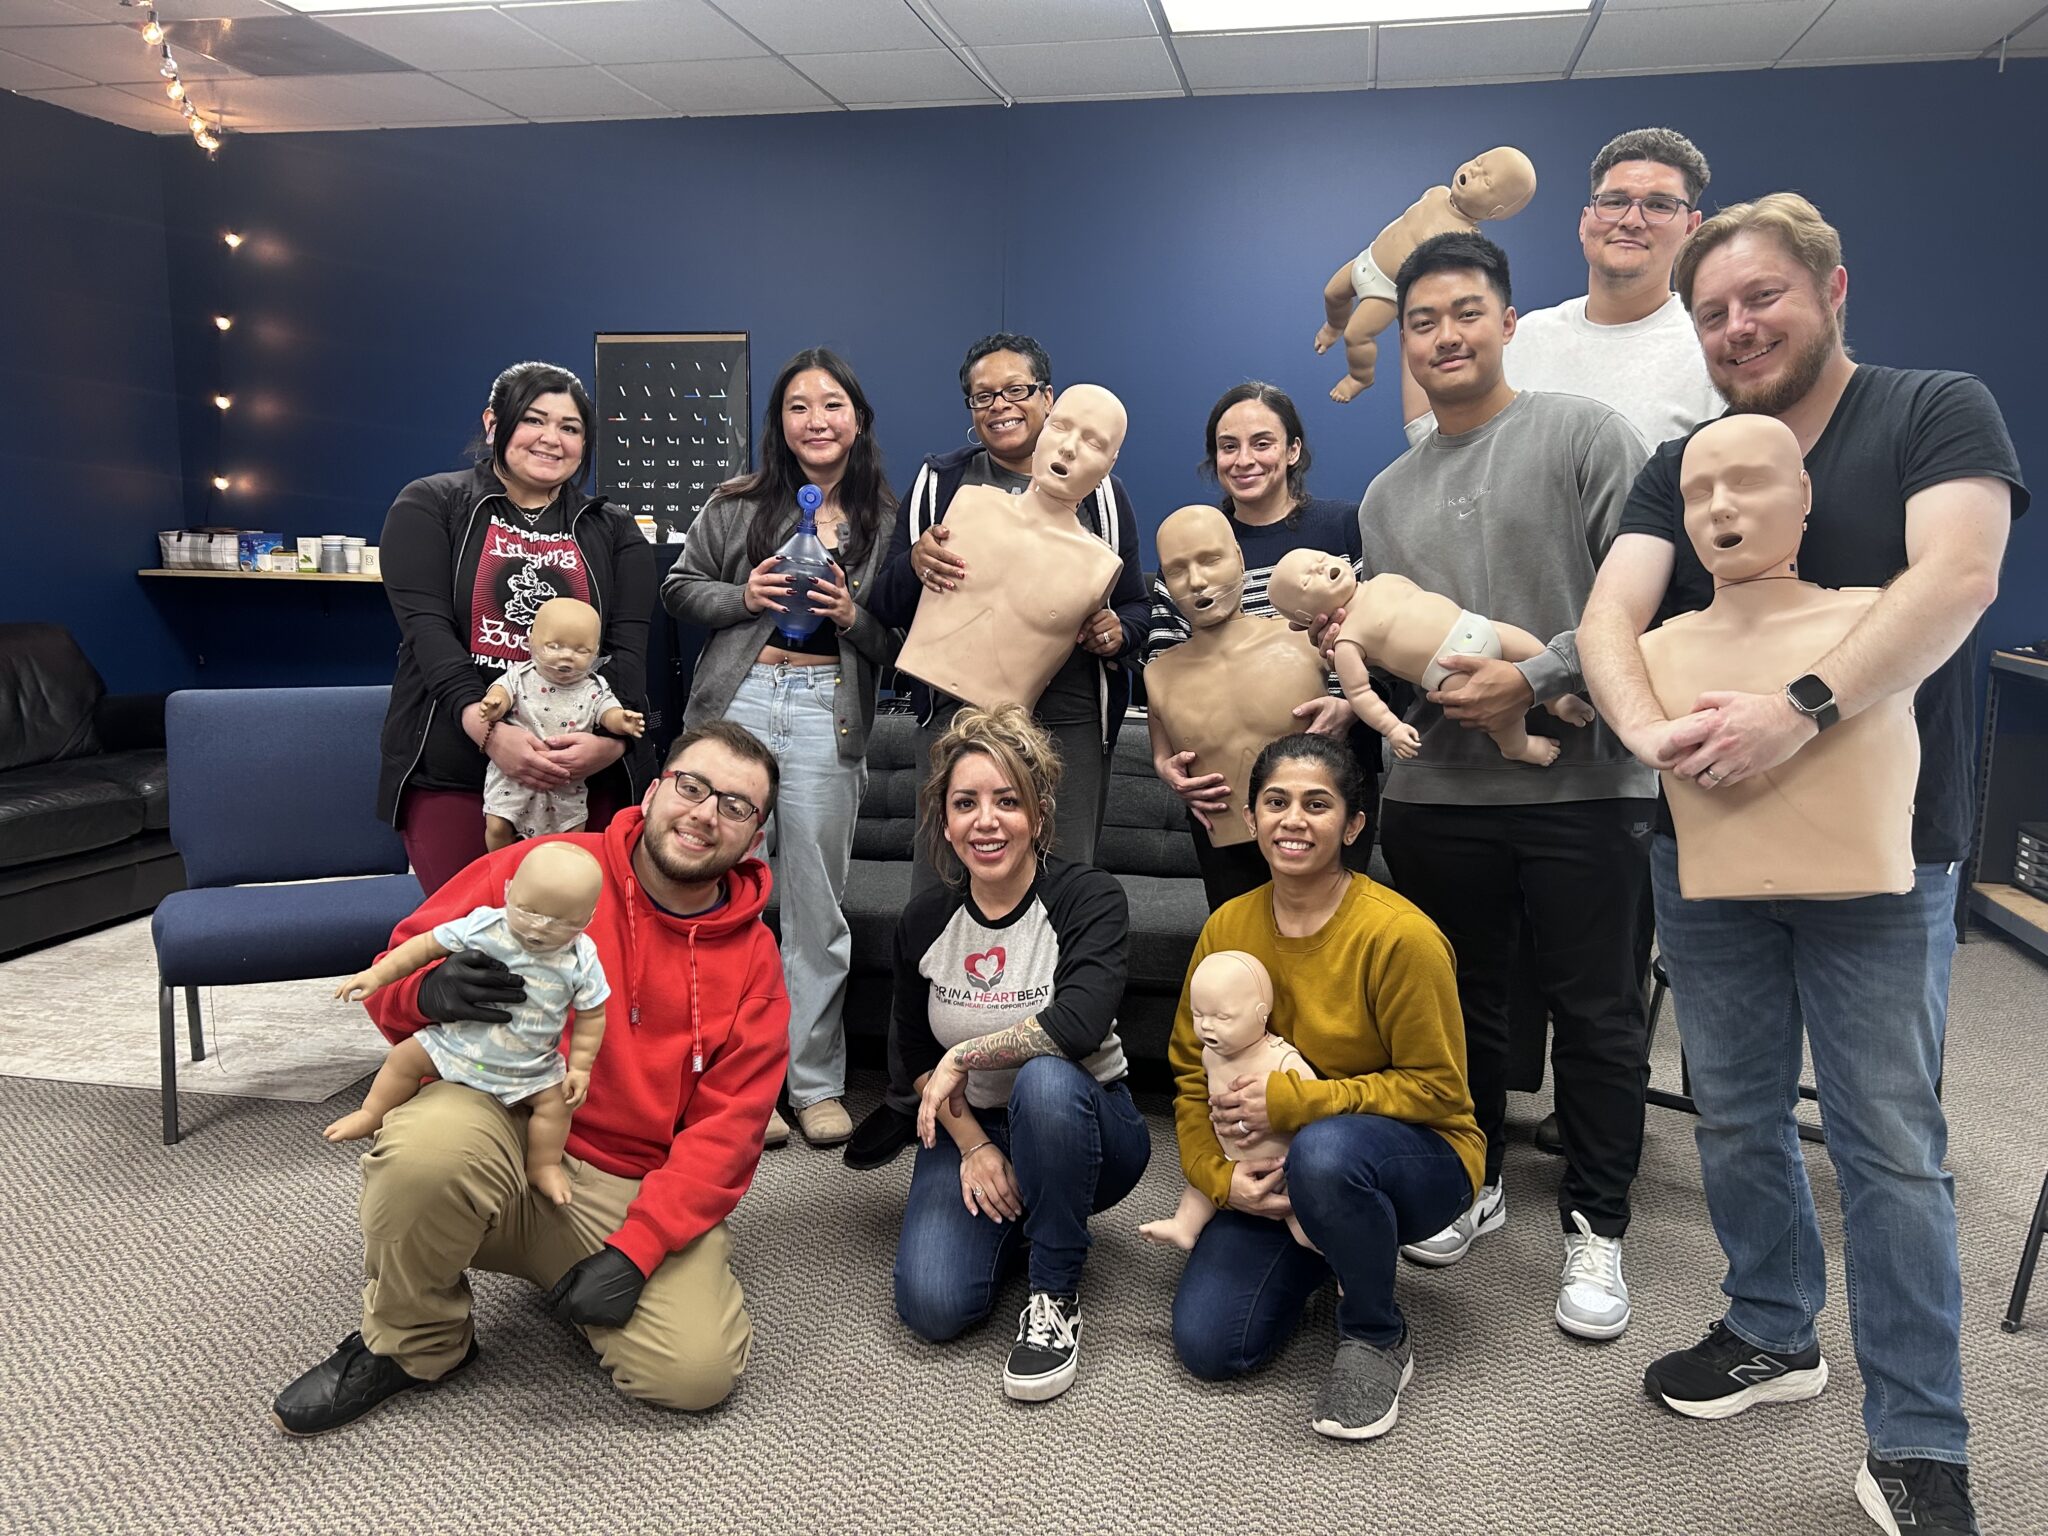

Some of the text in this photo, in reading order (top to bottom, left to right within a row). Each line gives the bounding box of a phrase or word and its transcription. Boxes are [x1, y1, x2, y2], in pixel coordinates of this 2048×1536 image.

[949, 987, 961, 999] IN
[962, 990, 972, 1001] A
[973, 984, 1050, 1003] HEARTBEAT
